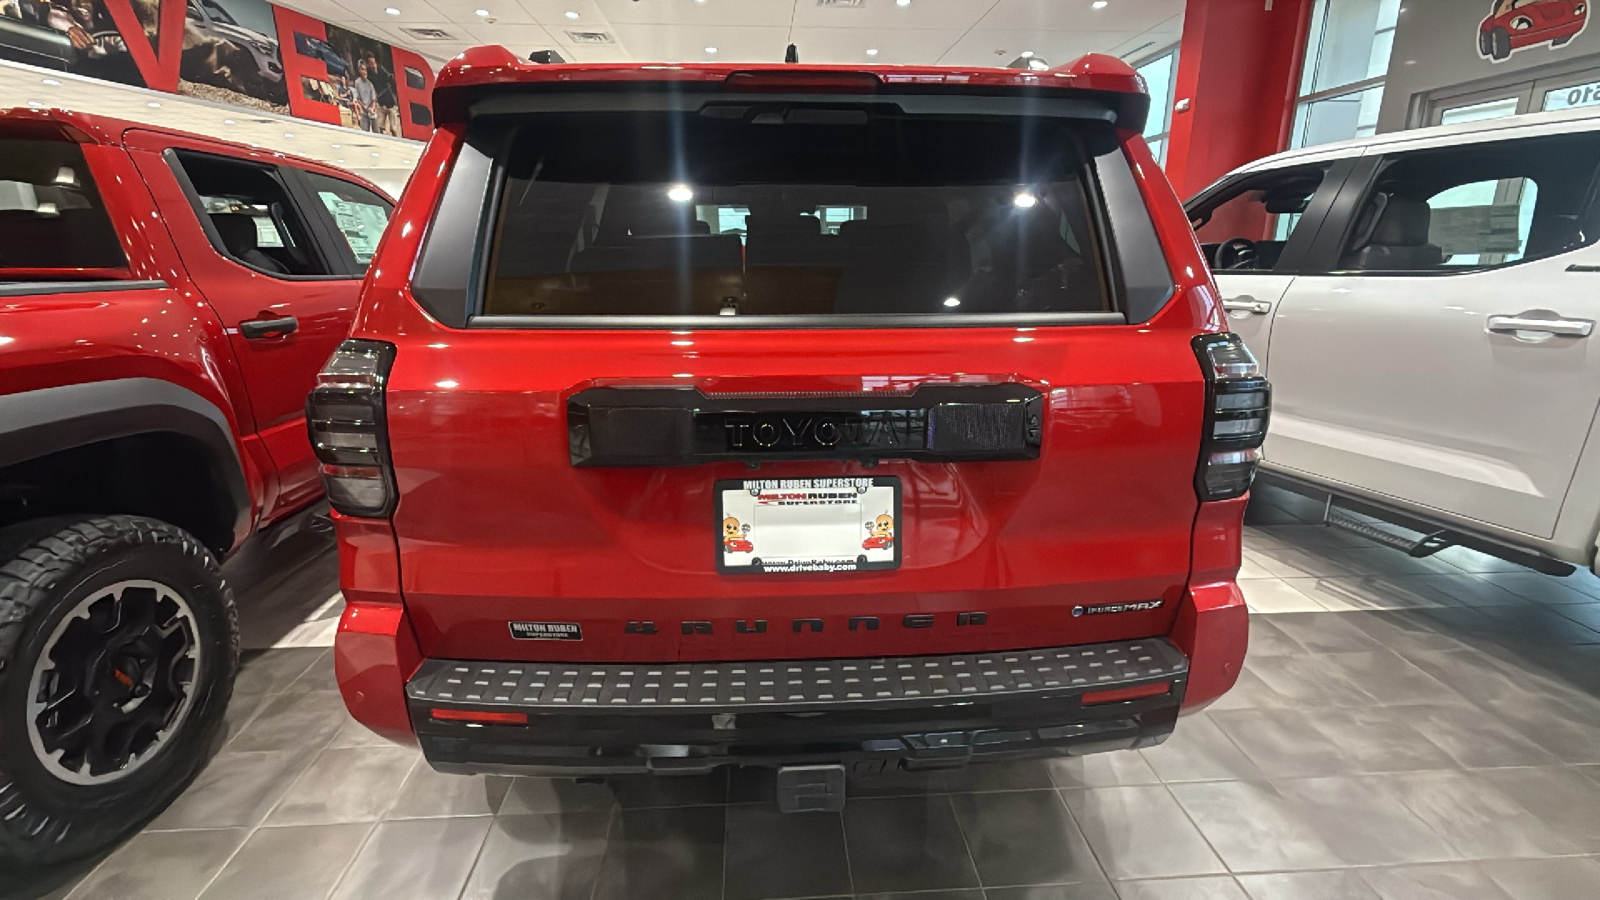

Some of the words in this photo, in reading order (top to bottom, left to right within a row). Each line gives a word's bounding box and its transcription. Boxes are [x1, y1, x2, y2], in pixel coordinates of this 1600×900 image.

[725, 417, 900, 447] TOYOTA
[743, 480, 778, 490] MILTON
[780, 479, 812, 489] RUBEN
[813, 477, 874, 489] SUPERSTORE
[763, 563, 857, 572] www.drivebaby.com
[1123, 599, 1164, 611] MAX
[512, 623, 546, 632] MILTON
[547, 624, 578, 632] RUBEN
[625, 611, 988, 635] 4RUNNER
